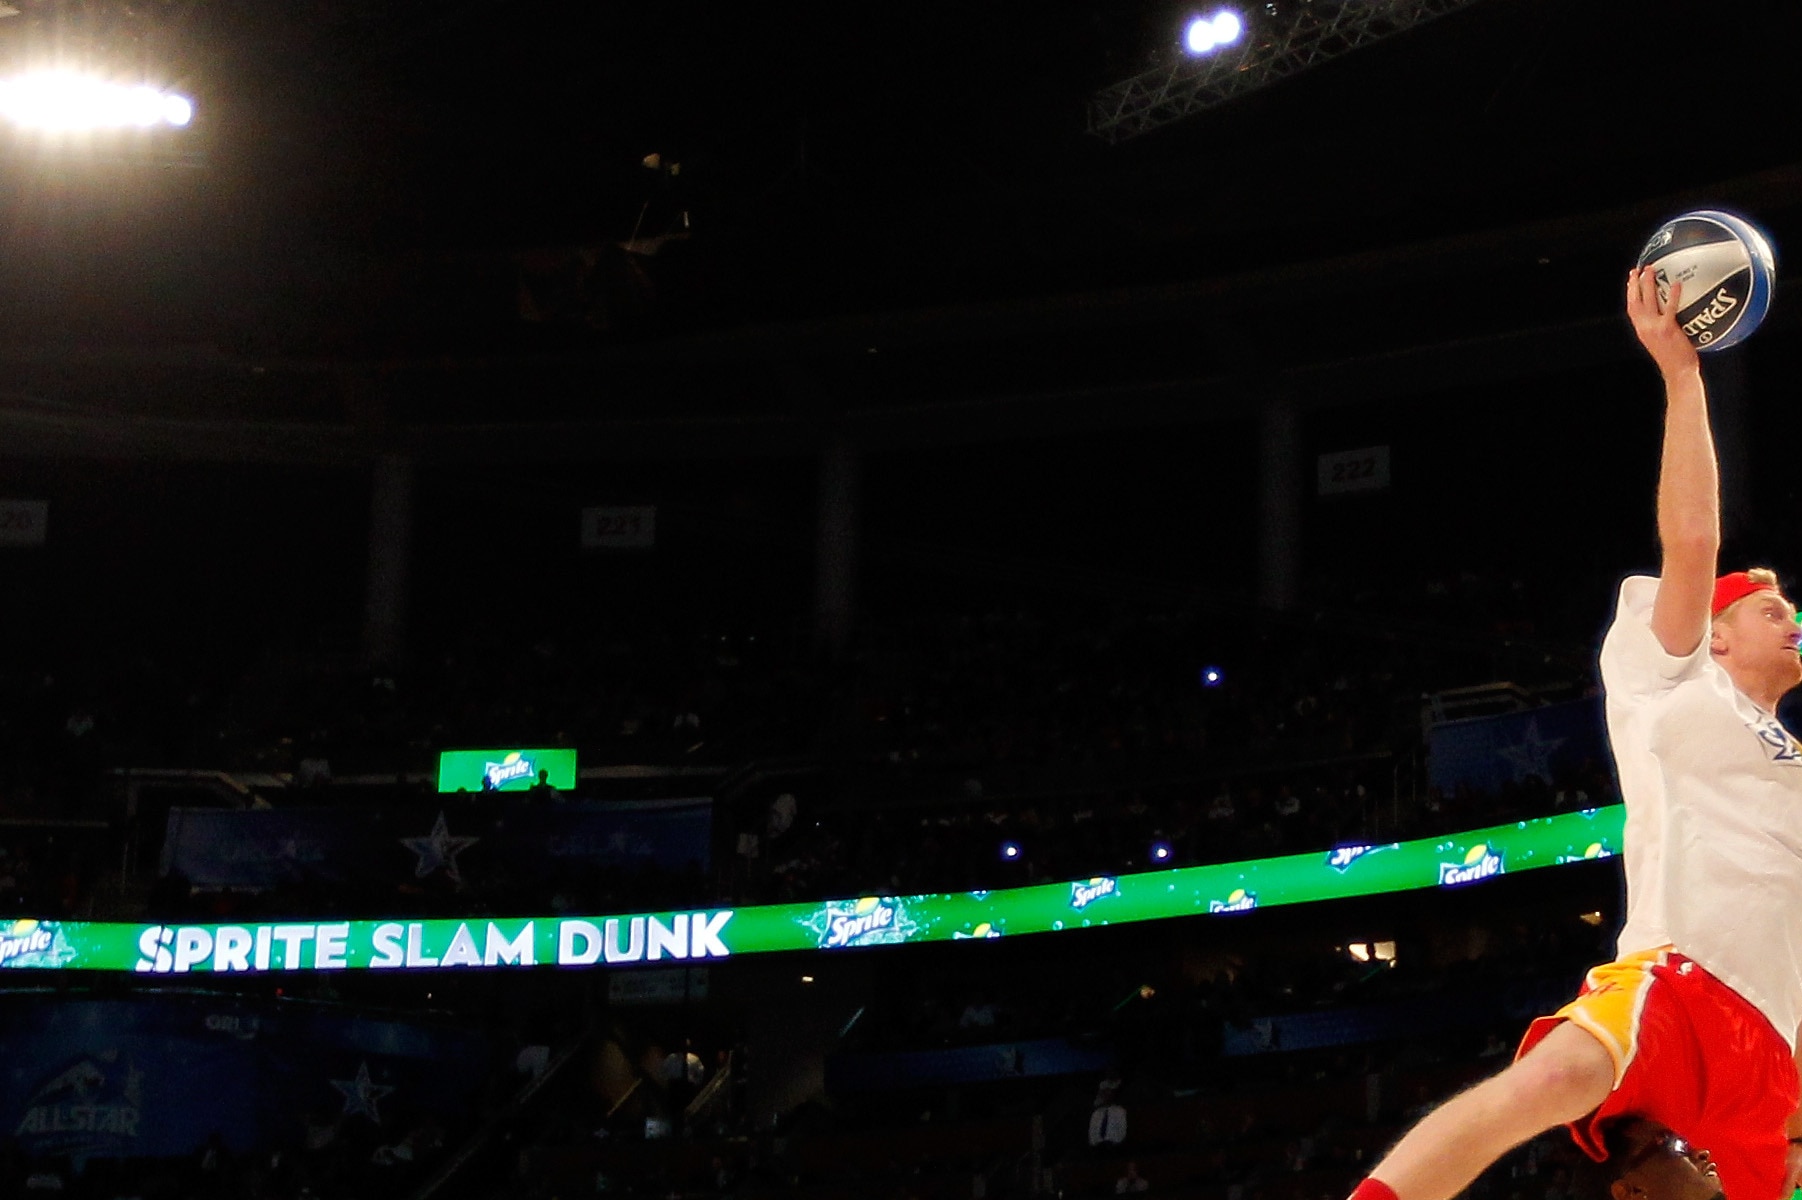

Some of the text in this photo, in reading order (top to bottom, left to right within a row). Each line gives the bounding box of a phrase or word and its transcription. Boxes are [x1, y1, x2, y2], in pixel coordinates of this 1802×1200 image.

[1333, 457, 1377, 482] 222
[135, 910, 733, 973] SPRITE SLAM DUNK
[827, 904, 894, 945] Sprite
